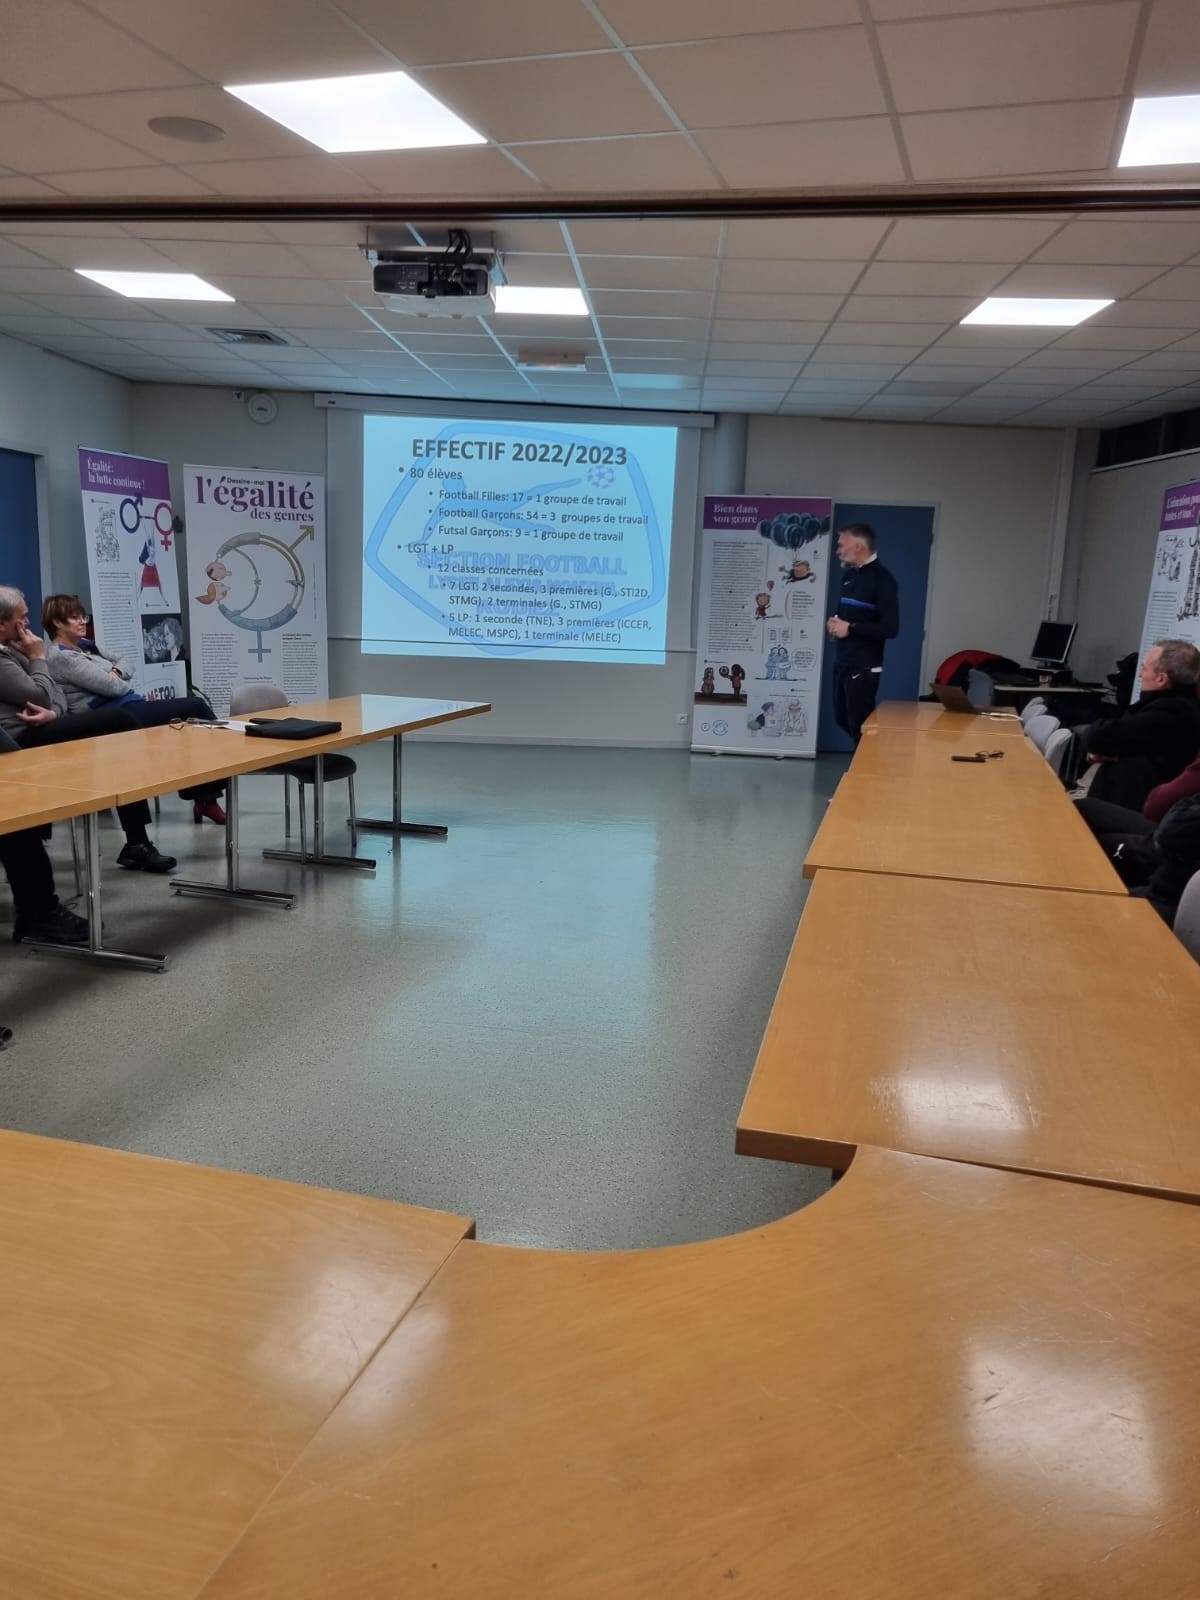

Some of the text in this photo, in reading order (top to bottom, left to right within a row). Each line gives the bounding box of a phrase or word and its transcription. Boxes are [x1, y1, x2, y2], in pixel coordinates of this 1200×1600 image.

[412, 439, 627, 467] EFFECTIF 2022/2023
[410, 467, 463, 480] 80 élèves
[195, 476, 314, 512] l'égalité
[439, 489, 479, 501] Football
[481, 491, 510, 502] Filles:
[512, 492, 524, 502] 17
[536, 494, 541, 502] 1
[543, 494, 579, 505] groupe
[581, 495, 594, 504] de
[596, 496, 627, 506] travail
[250, 508, 314, 522] des genres
[439, 507, 478, 518] Football
[480, 509, 524, 521] Garçons:
[526, 511, 539, 520] 54
[550, 512, 556, 521] 3
[561, 513, 601, 524] groupes
[603, 513, 616, 523] de
[618, 514, 649, 525] travail
[713, 504, 758, 514] Bien dans
[713, 515, 758, 525] son genre
[438, 525, 468, 536] Futsal
[470, 526, 513, 539] Garçons:
[515, 528, 521, 538] 9
[533, 529, 539, 538] 1
[541, 530, 576, 541] groupe
[578, 530, 591, 540] de
[593, 532, 624, 542] travail
[407, 543, 429, 554] LGT
[441, 544, 454, 554] LP
[438, 563, 544, 577] 12 classes concernées
[450, 581, 456, 591] 7
[458, 581, 479, 591] LGT:
[481, 582, 488, 592] 2
[490, 583, 538, 595] secondes,
[540, 585, 547, 594] 3
[549, 585, 598, 597] premières
[600, 586, 617, 598] (G.,
[449, 595, 602, 611] STMG), 2 terminales (G., STMG)
[449, 613, 652, 630] 5 LP: 1 seconde (TNE), 3 premières (ICCER,
[448, 627, 622, 643] MELEC, MSPC), 1 terminale (MELEC)
